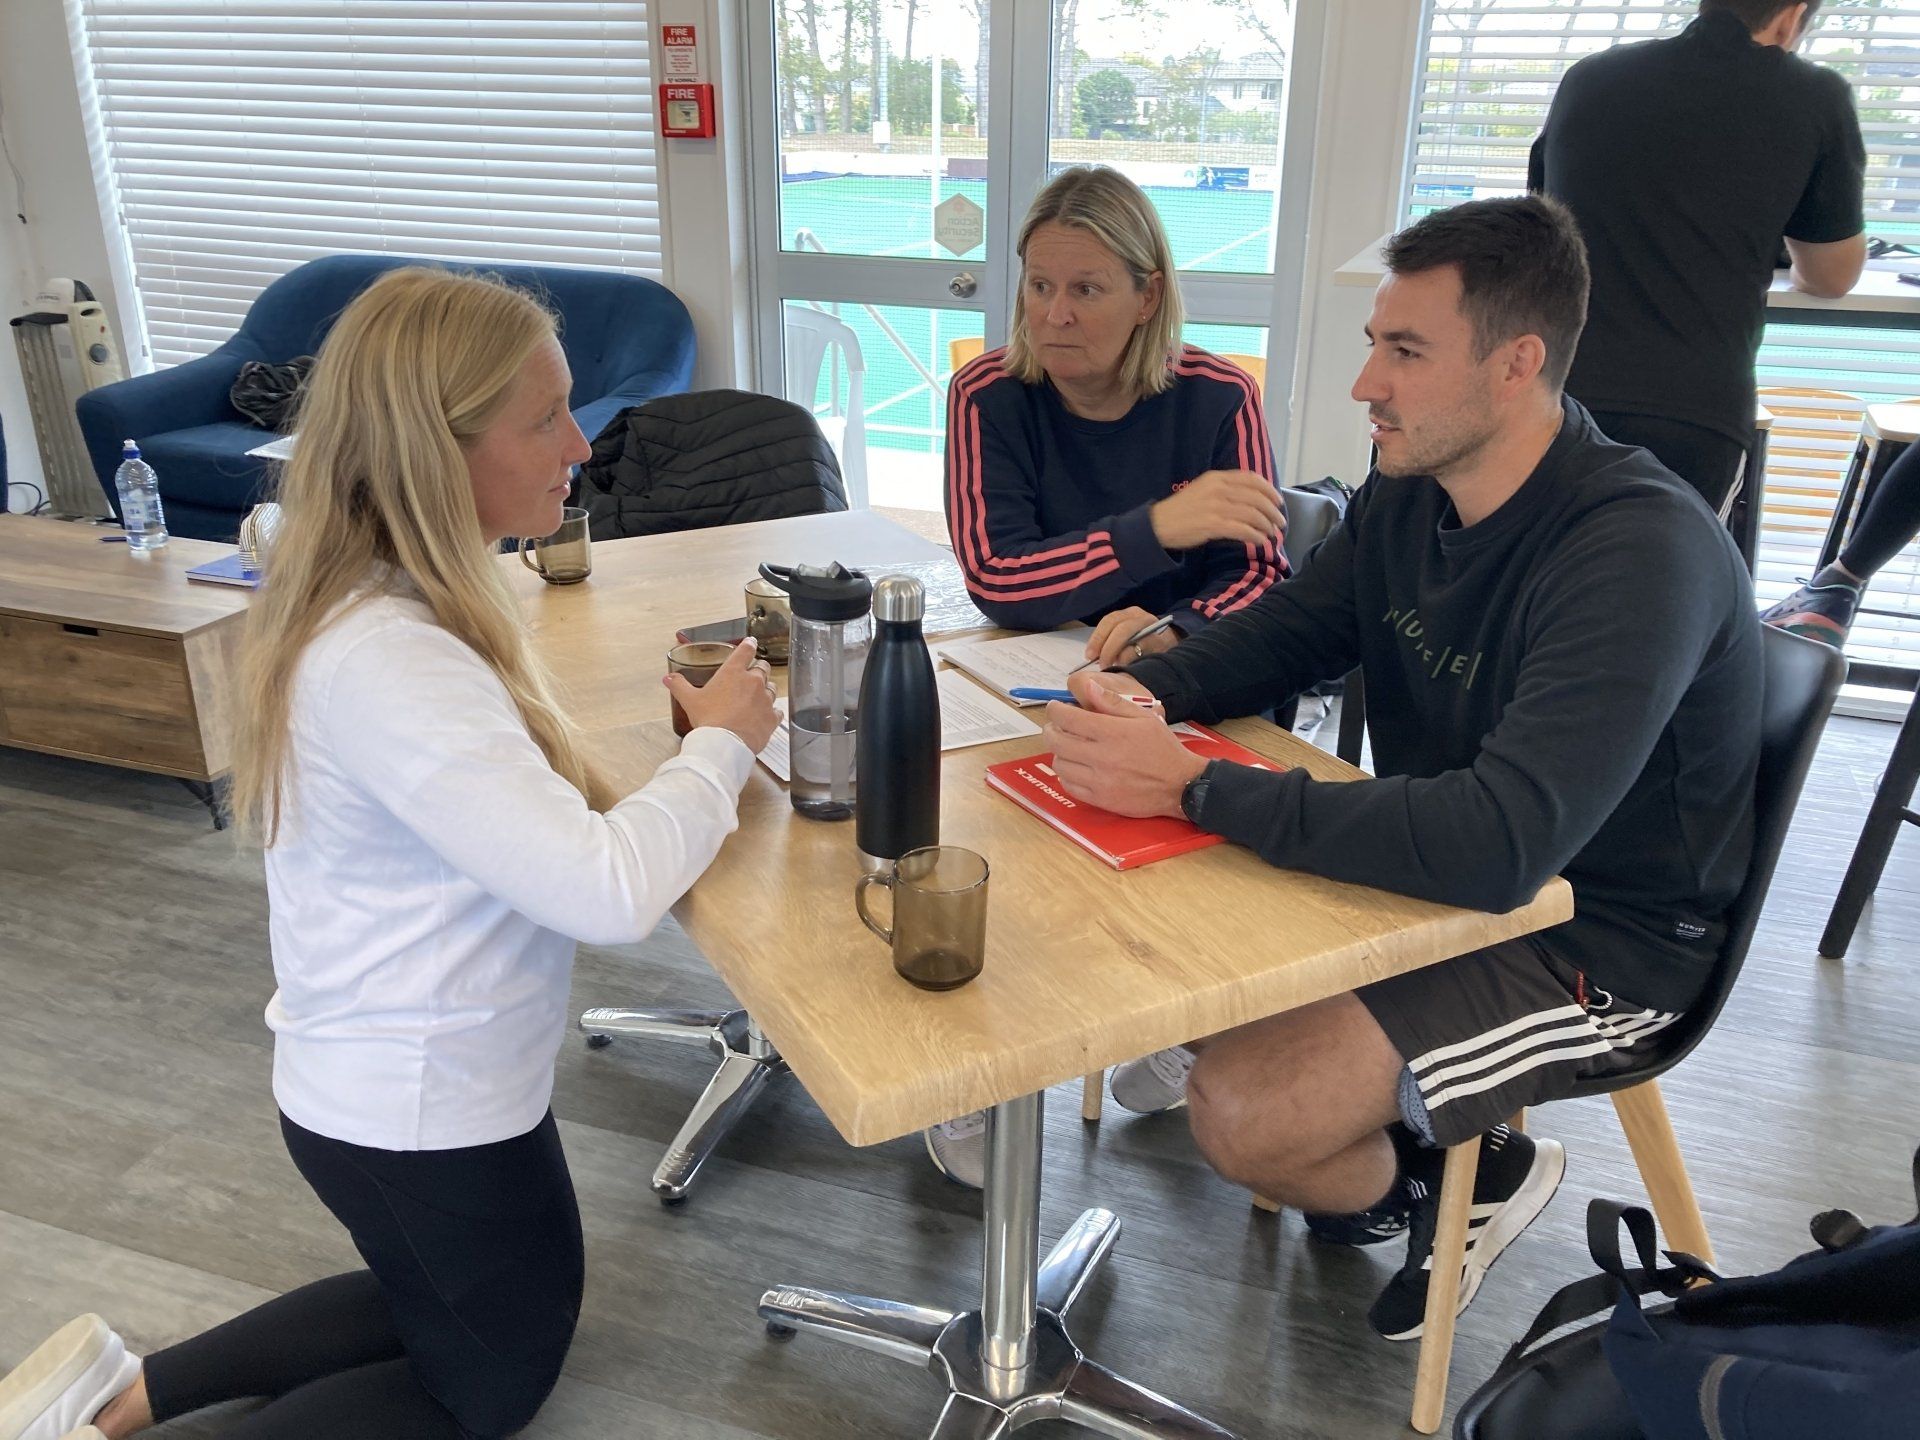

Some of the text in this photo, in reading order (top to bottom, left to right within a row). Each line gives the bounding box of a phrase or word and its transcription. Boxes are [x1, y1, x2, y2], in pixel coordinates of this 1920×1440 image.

[670, 28, 689, 36] FIRE
[666, 37, 693, 45] ALARM
[667, 88, 696, 99] FIRE
[1013, 766, 1077, 809] WARWICK
